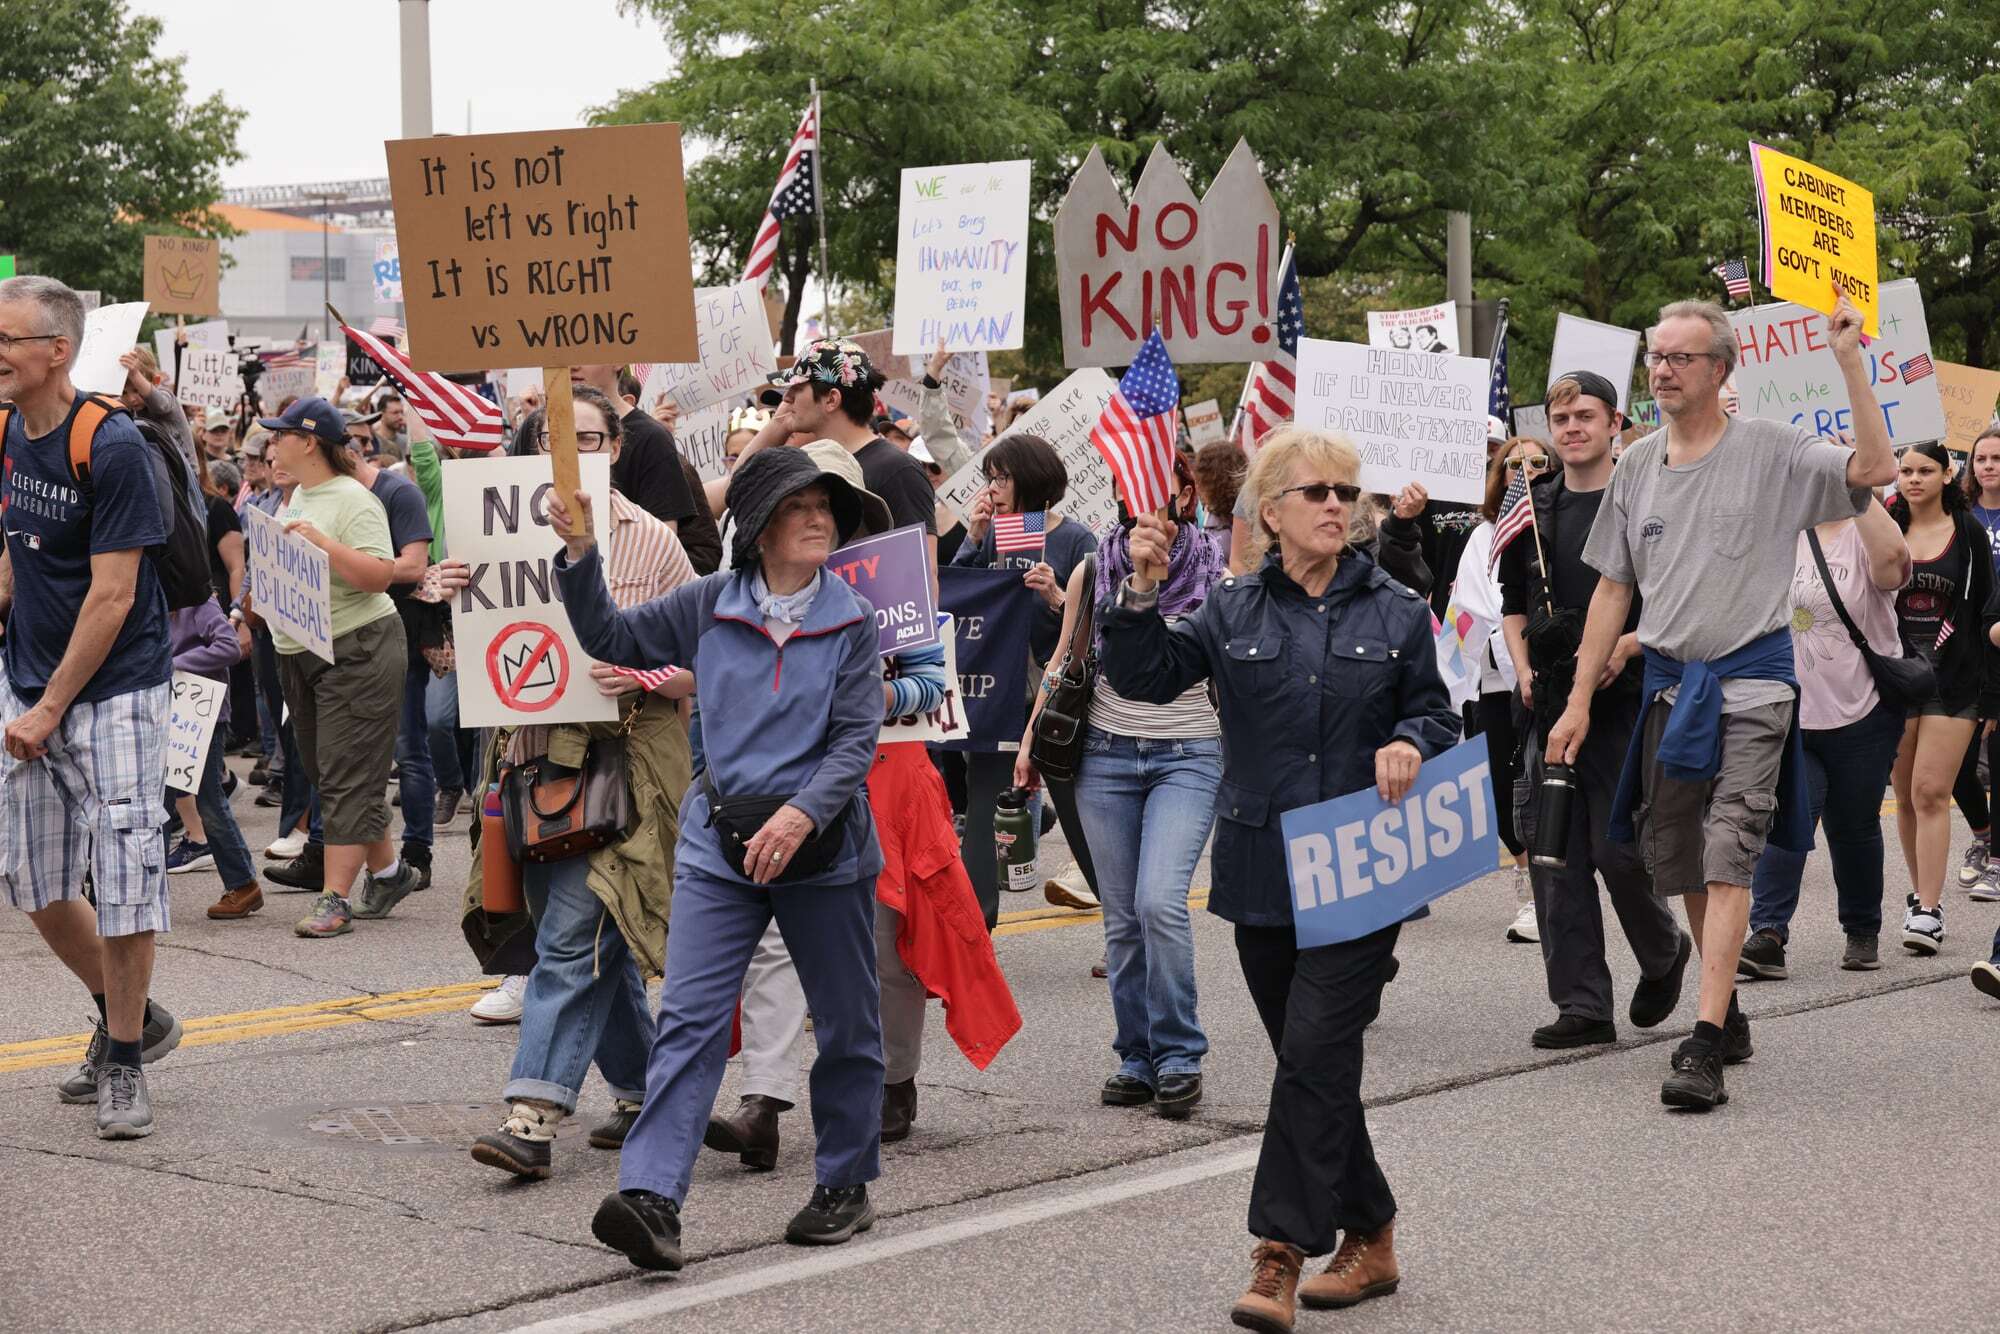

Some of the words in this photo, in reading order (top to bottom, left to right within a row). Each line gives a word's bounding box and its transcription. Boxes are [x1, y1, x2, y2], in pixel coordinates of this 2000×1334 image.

[420, 157, 447, 197] It
[469, 152, 496, 193] is
[514, 145, 565, 188] not
[915, 175, 947, 198] WE
[1783, 167, 1846, 208] CABINET
[464, 202, 511, 241] left
[525, 212, 553, 237] vs
[567, 194, 639, 250] right
[1095, 202, 1199, 258] NO
[1779, 193, 1855, 240] MEMBERS
[158, 238, 176, 250] NO
[919, 239, 1019, 274] HUMANITY
[1812, 230, 1841, 257] ARE
[427, 258, 462, 299] It
[485, 257, 509, 296] is
[527, 256, 613, 296] RIGHT
[1080, 223, 1271, 348] KING!
[1777, 246, 1821, 280] GOV'T
[1830, 266, 1871, 303] WASTE
[471, 324, 501, 348] vs
[517, 312, 639, 348] WRONG
[920, 311, 1014, 346] HUMAN
[1734, 314, 1829, 368] HATE
[350, 356, 382, 376] KIN
[1367, 349, 1449, 381] HONK
[1313, 372, 1338, 397] IF
[1350, 375, 1369, 399] U
[1379, 380, 1473, 411] NEVER
[1324, 406, 1489, 446] DRUNK-TEXTED
[1410, 447, 1485, 480] PLANS
[10, 490, 67, 522] BASEBALL
[12, 471, 79, 504] CLEVELAND
[250, 521, 269, 557] NO
[275, 534, 321, 591] HUMAN
[256, 567, 268, 604] IS
[273, 577, 327, 642] ILLEGAL
[896, 623, 925, 640] ACLU
[1289, 760, 1490, 911] RESIST
